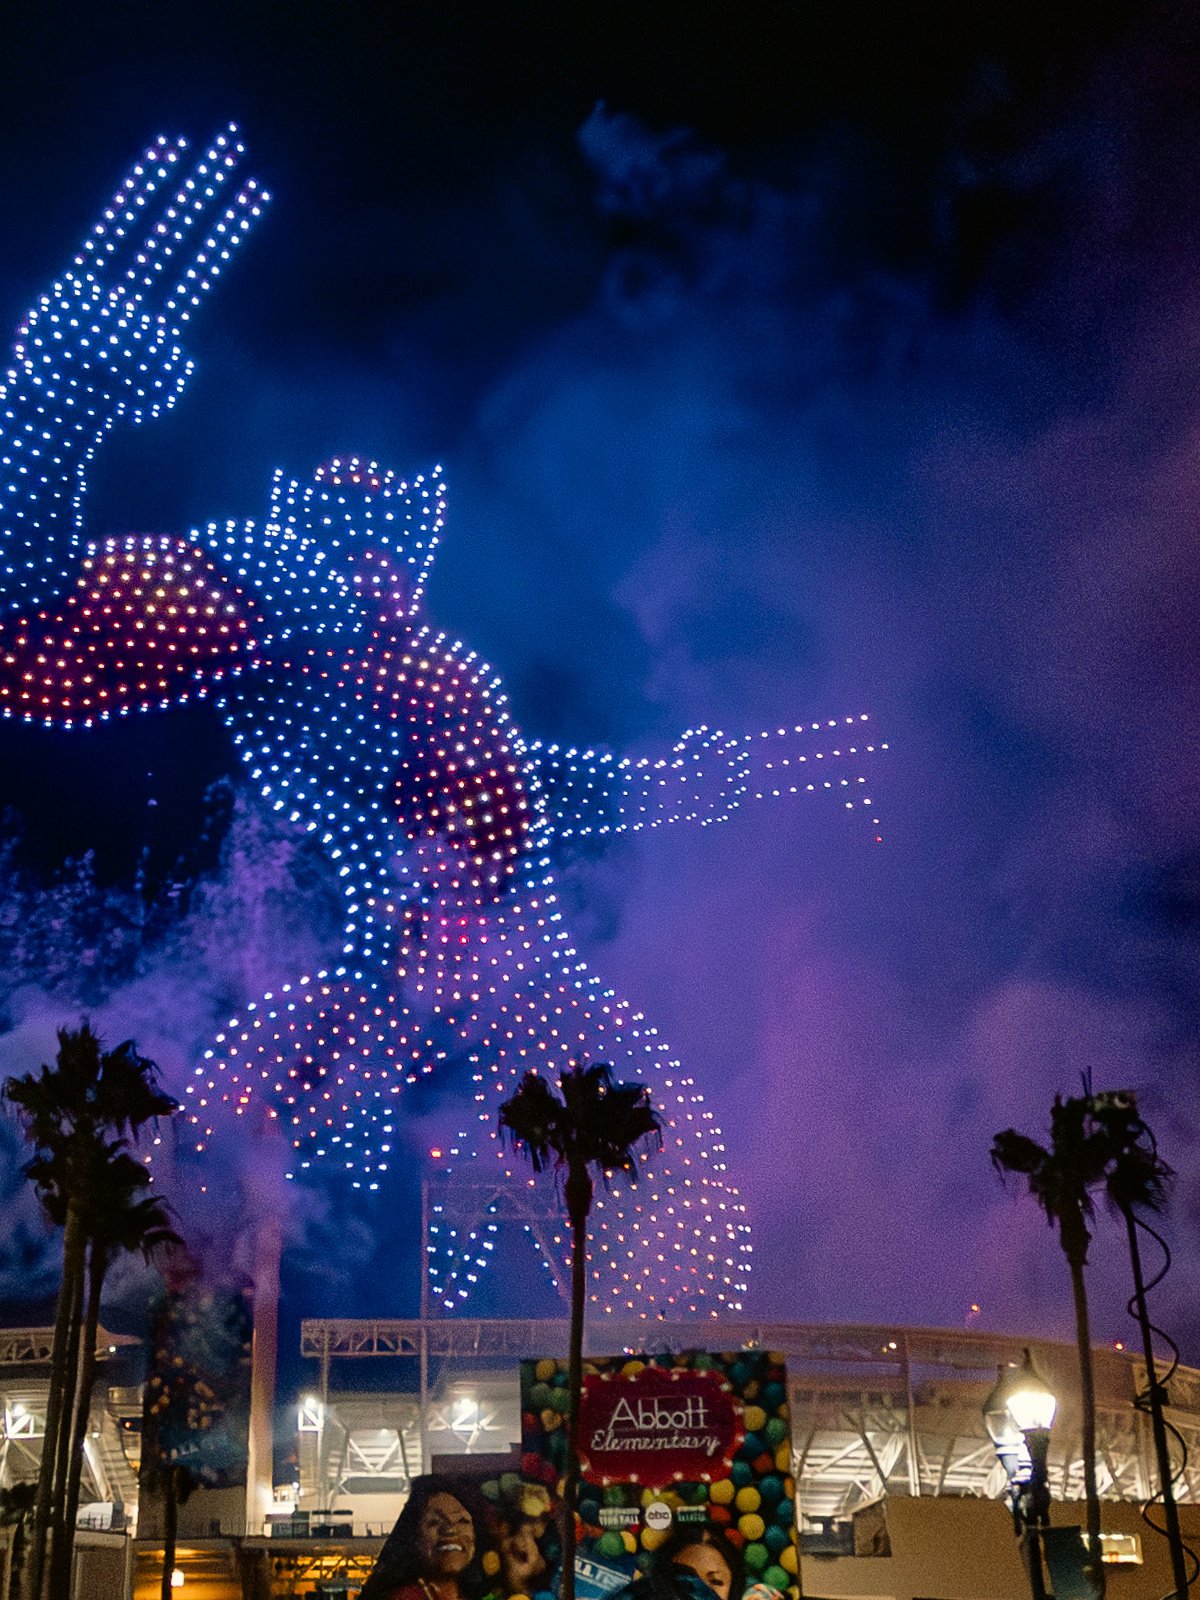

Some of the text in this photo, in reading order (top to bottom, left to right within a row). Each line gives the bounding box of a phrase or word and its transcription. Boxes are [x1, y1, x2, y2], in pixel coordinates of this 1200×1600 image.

[607, 1396, 709, 1430] Abbott
[591, 1428, 720, 1456] Elementary
[647, 1510, 670, 1520] abc
